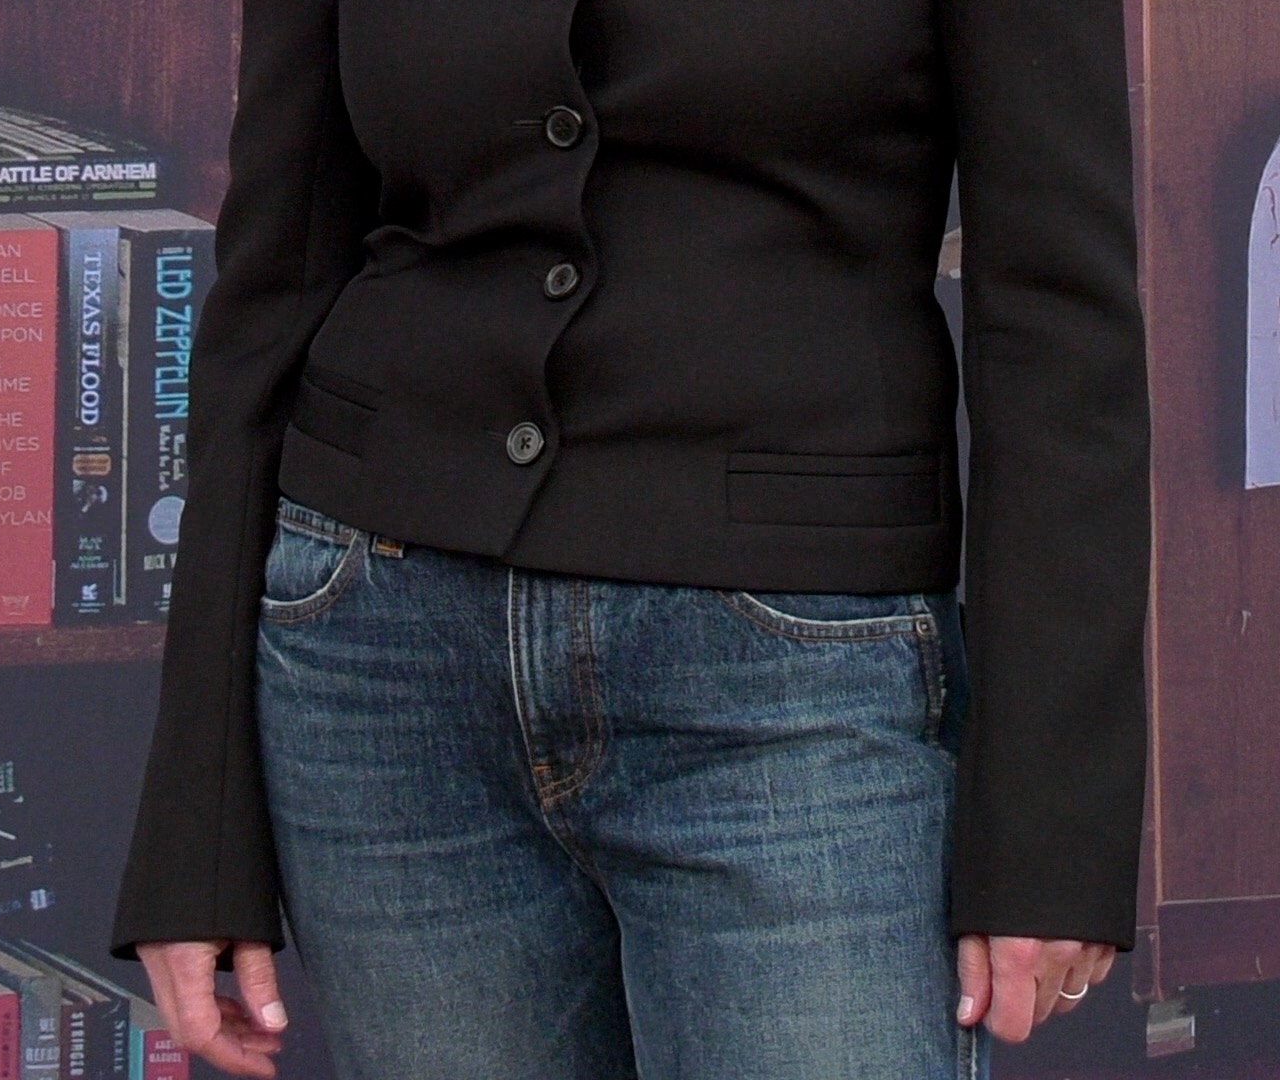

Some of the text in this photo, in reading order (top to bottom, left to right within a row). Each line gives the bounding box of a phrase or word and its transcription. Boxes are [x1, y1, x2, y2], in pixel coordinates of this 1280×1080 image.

[53, 164, 79, 181] OF
[81, 162, 158, 181] ARNHEM
[155, 255, 193, 300] LED
[81, 252, 103, 426] TEXAS FLOOD
[154, 305, 192, 419] ZEPPELIN
